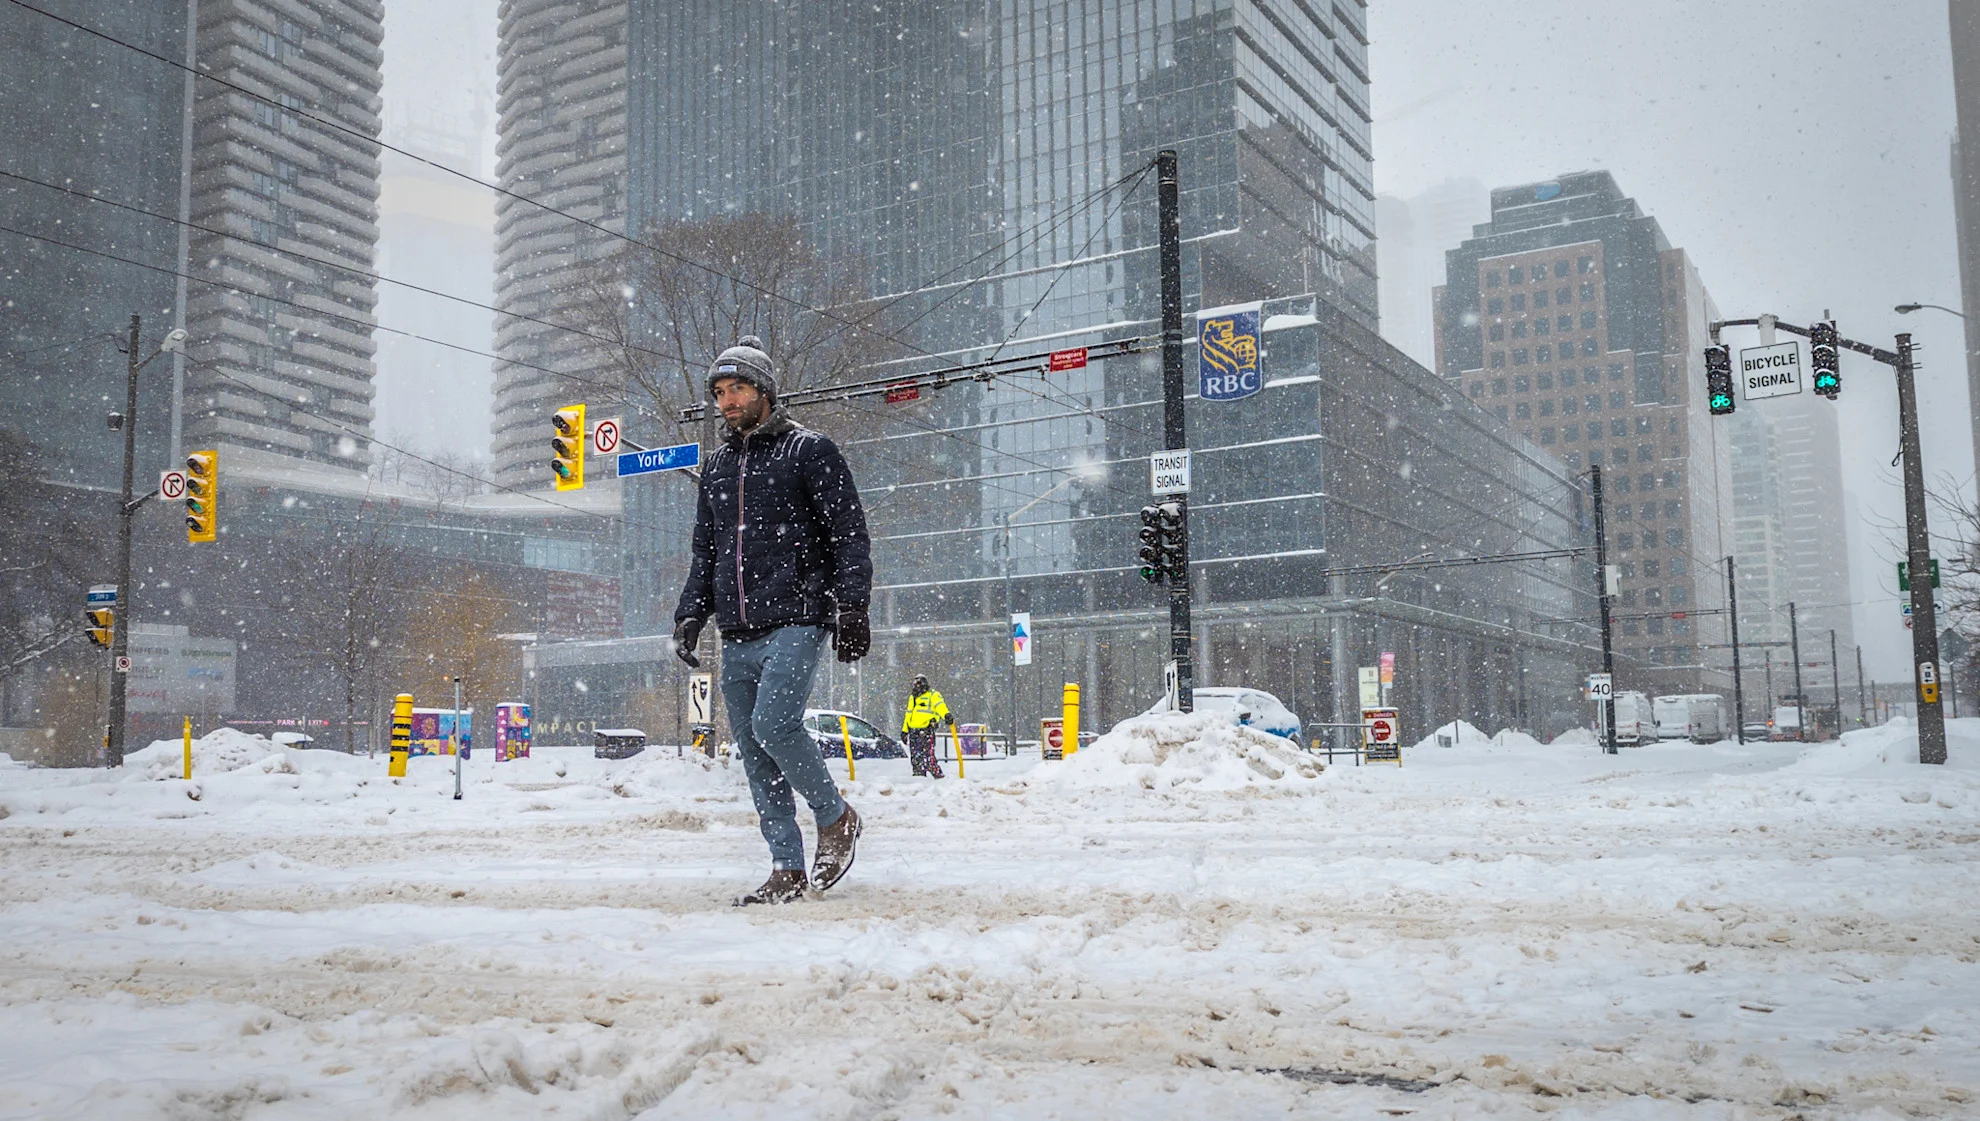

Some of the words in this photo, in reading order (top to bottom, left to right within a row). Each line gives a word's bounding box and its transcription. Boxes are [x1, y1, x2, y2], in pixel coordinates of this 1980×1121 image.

[1744, 353, 1796, 371] BICYCLE
[1206, 372, 1255, 395] RBC
[1749, 372, 1795, 389] SIGNAL
[637, 451, 665, 468] York
[669, 449, 676, 457] St
[1154, 456, 1187, 471] TRANSIT
[1156, 473, 1186, 488] SIGNAL
[1591, 683, 1610, 695] 40
